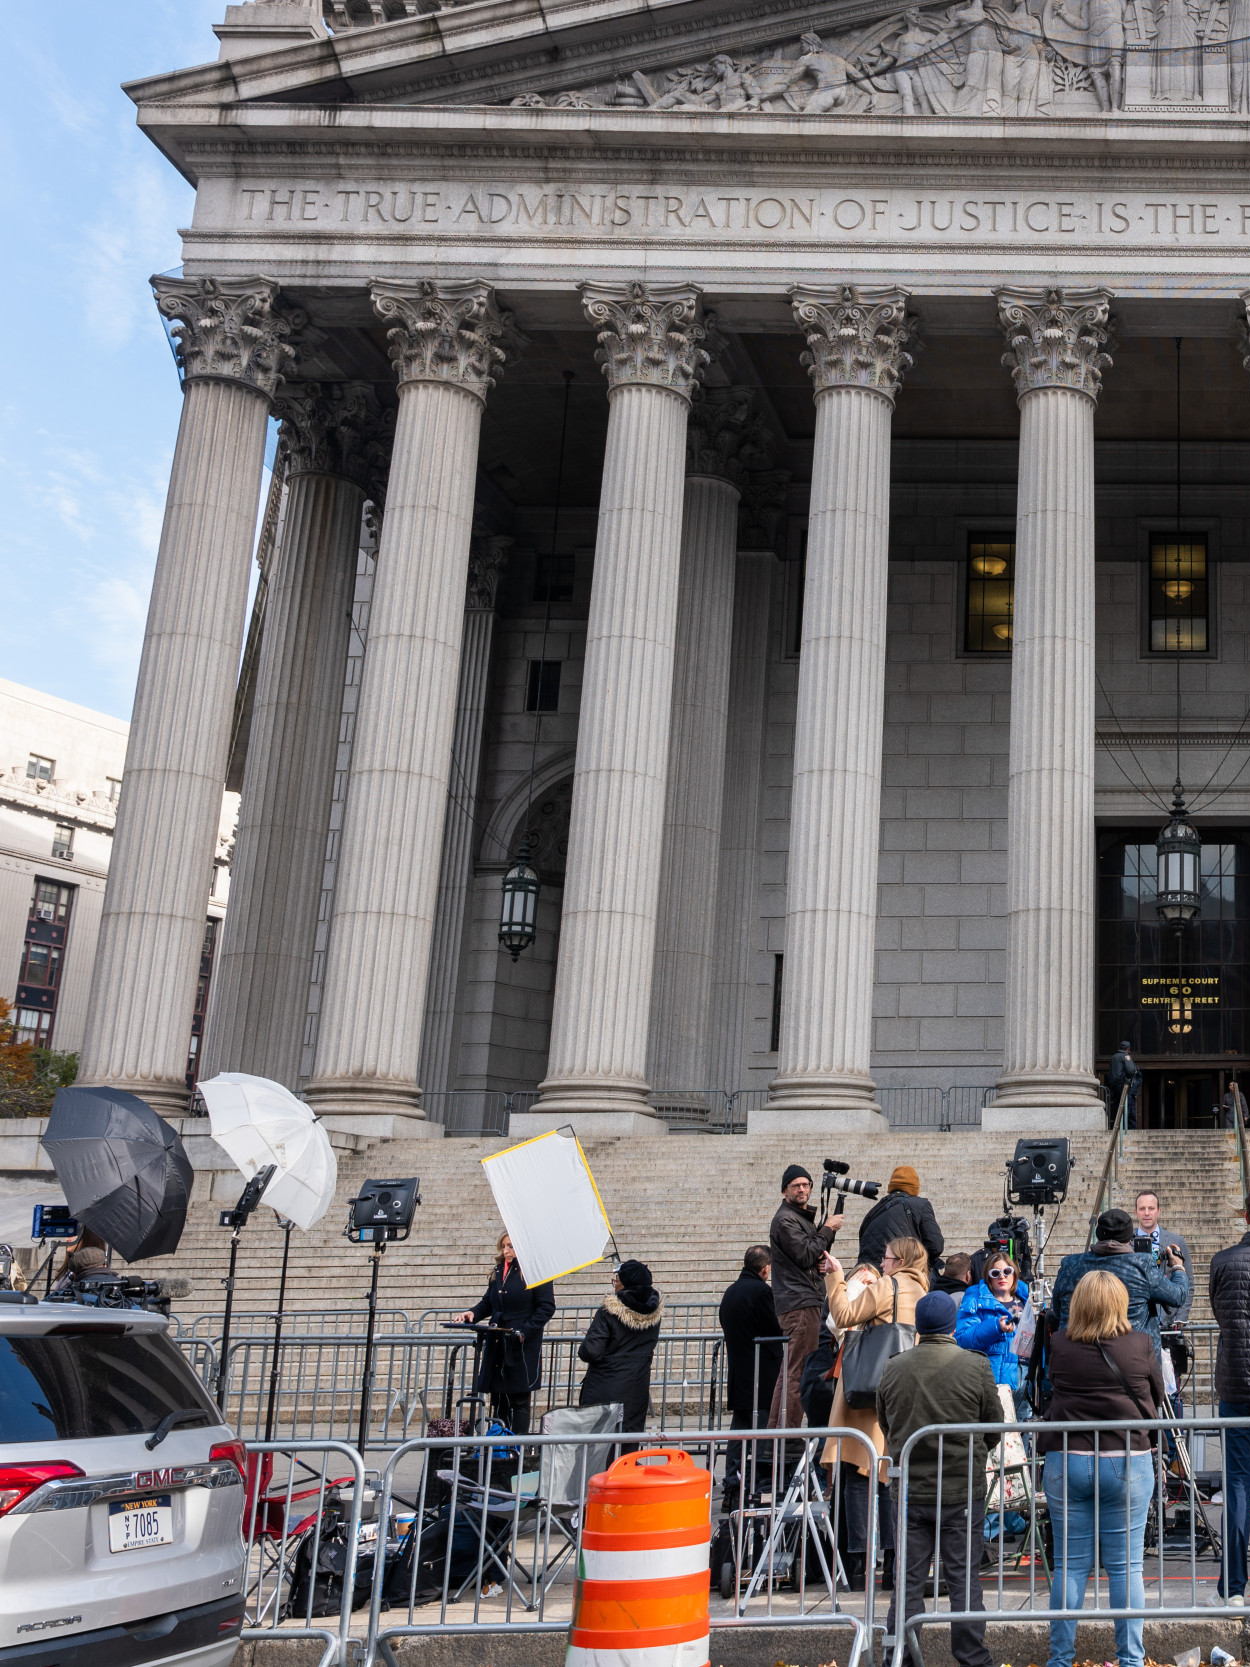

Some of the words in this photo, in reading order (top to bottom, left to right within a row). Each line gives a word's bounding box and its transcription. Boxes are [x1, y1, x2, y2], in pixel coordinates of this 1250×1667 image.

[241, 189, 319, 222] THE
[337, 190, 440, 223] TRUE
[452, 192, 816, 231] ADMINISTRATION
[832, 199, 890, 231] OF
[897, 200, 1075, 233] JUSTICE
[1094, 202, 1131, 234] IS
[1146, 203, 1221, 235] THE
[136, 1468, 186, 1489] GMC
[125, 1501, 140, 1510] NEW
[141, 1499, 157, 1508] YORK
[133, 1511, 158, 1538] 7085
[17, 1615, 82, 1634] ACADIA
